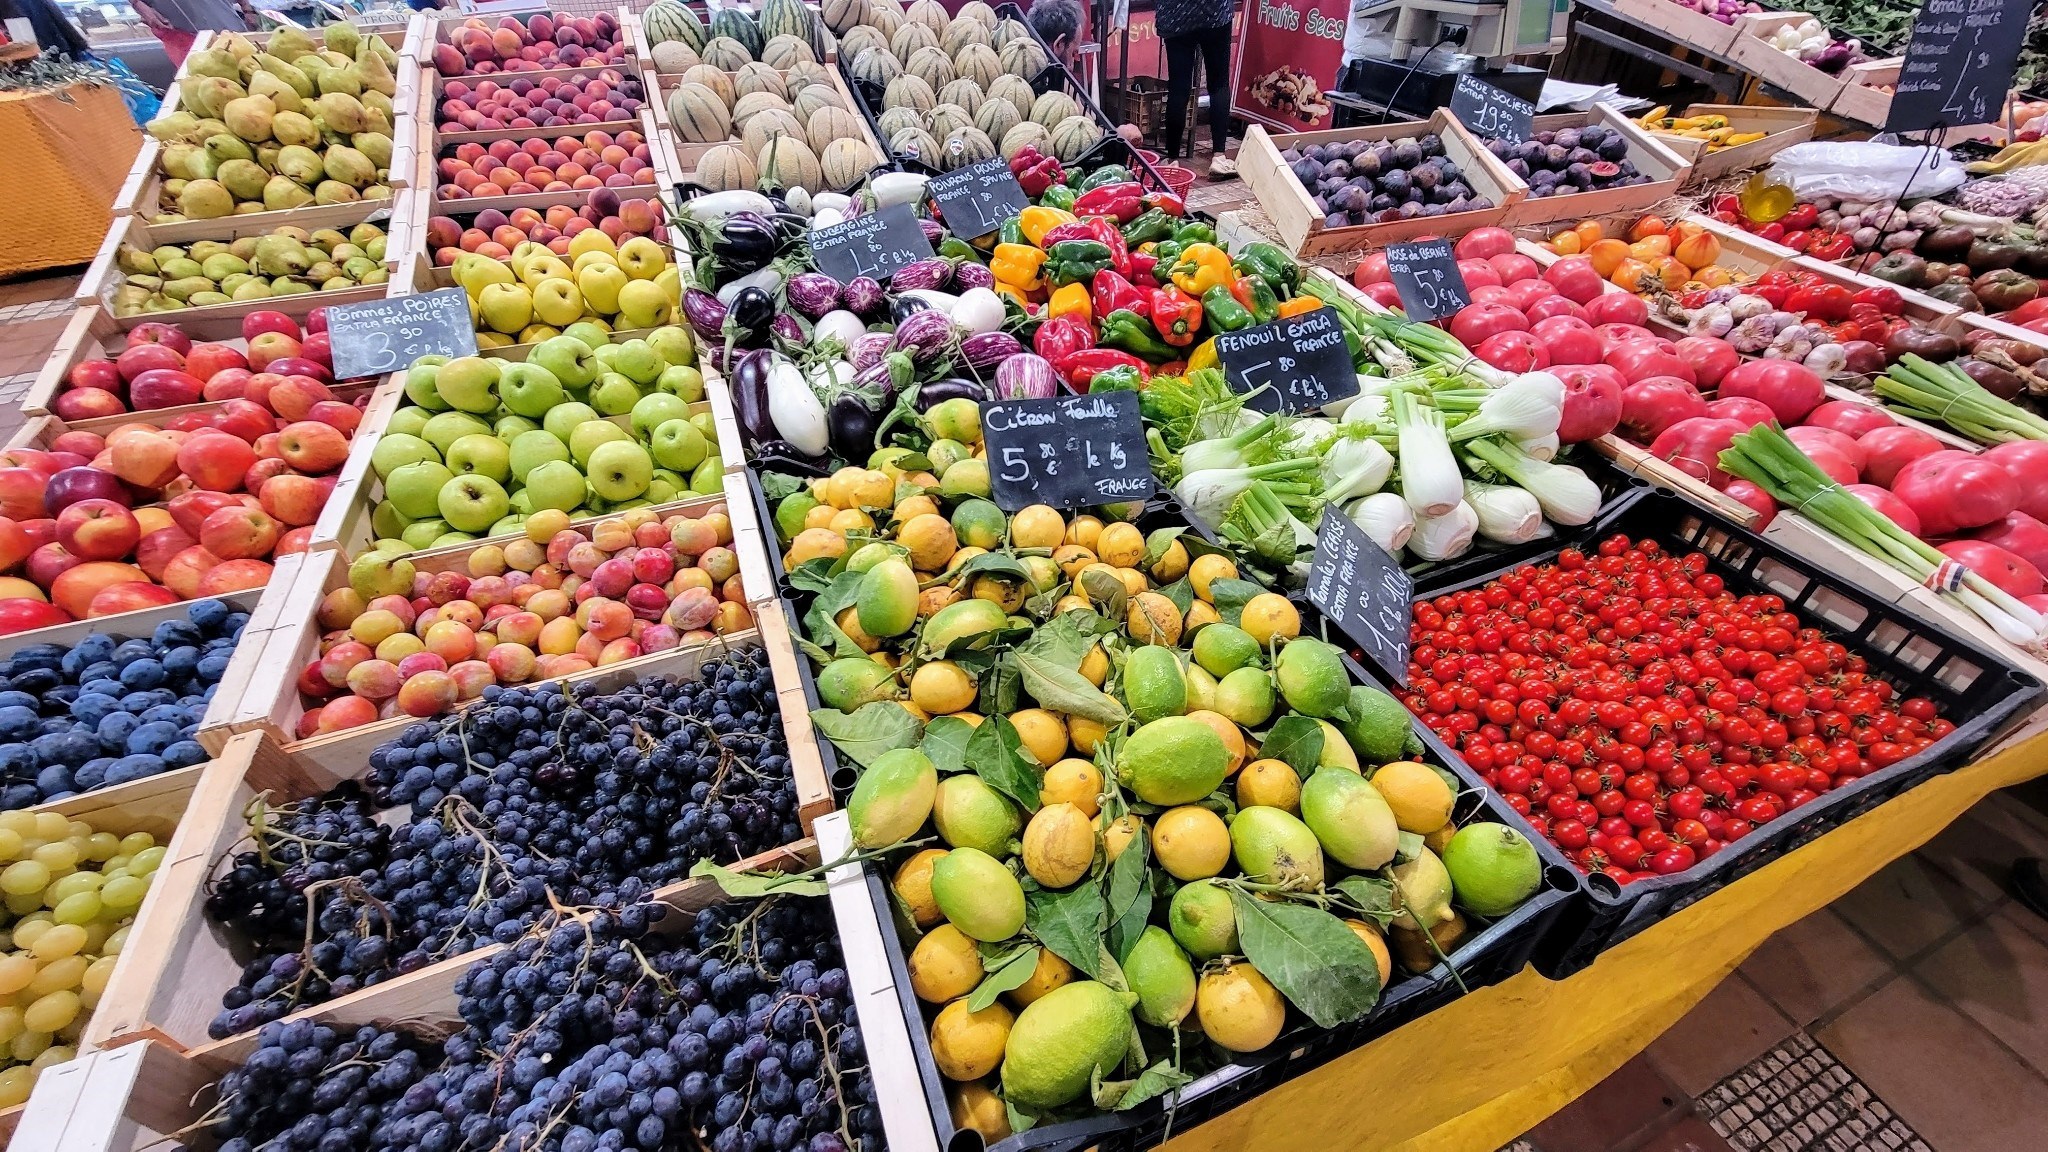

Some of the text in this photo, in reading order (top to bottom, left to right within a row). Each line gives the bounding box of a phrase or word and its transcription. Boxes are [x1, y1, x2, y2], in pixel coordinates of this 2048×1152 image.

[1258, 0, 1345, 40] Fruits Secs
[1458, 83, 1484, 101] EXTRA
[973, 156, 1006, 176] ROUGE
[936, 185, 971, 203] FRANCE
[811, 214, 877, 241] AUBERGINE
[812, 220, 888, 251] EXTRA FRANCE
[382, 310, 442, 327] FRANCE
[1287, 314, 1332, 338] EXTRA
[400, 327, 423, 340] 90
[1293, 331, 1342, 353] FRANCE
[404, 343, 418, 354] €
[1278, 356, 1296, 372] 80
[1339, 538, 1360, 586] FRANCE
